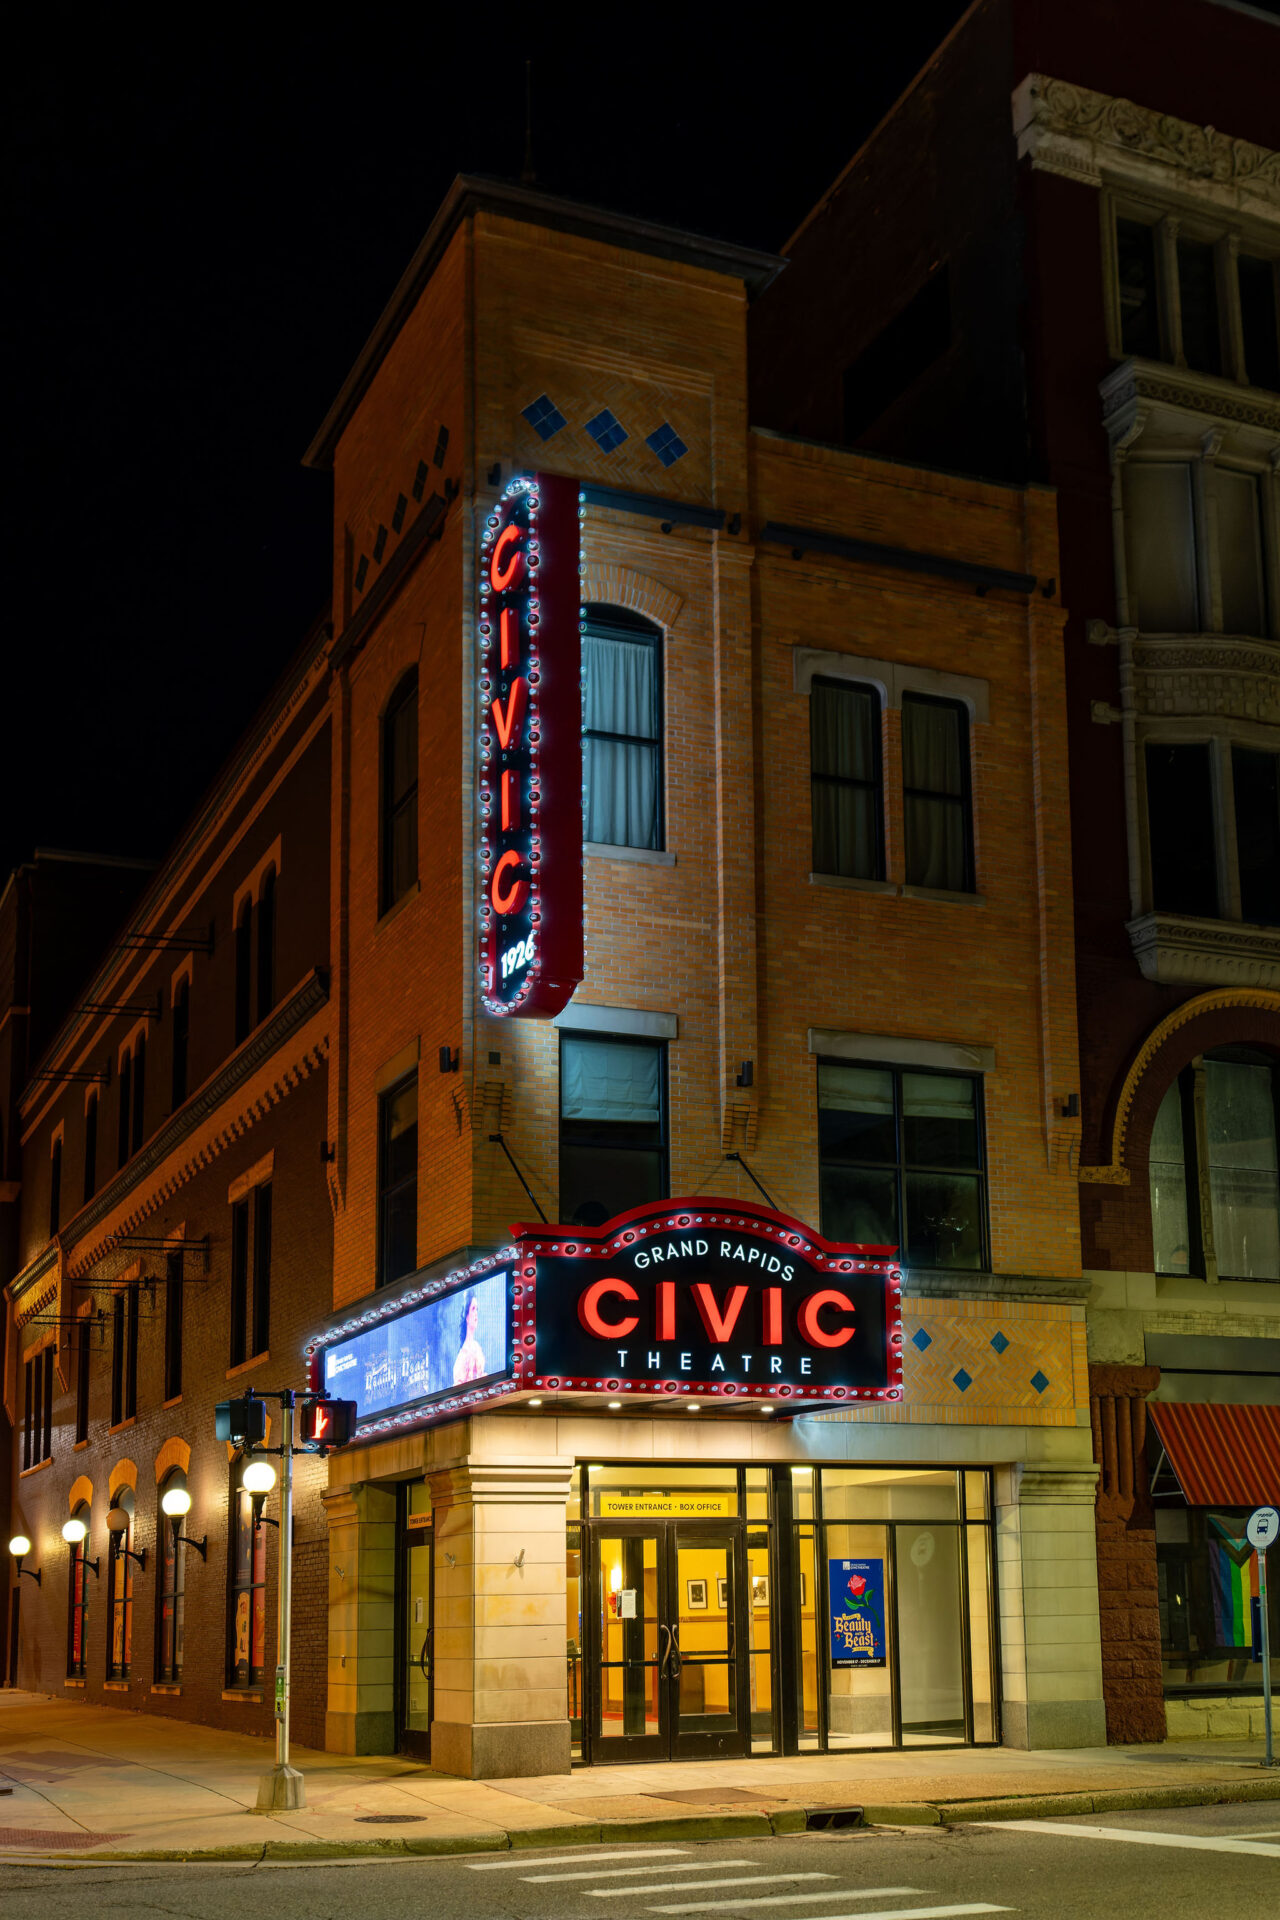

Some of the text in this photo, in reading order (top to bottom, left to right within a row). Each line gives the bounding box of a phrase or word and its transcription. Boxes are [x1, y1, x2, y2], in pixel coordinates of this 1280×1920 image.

[490, 524, 530, 915] CIVIC
[501, 933, 535, 979] 1926
[634, 1239, 795, 1282] GRAND RAPIDS
[577, 1277, 857, 1349] CIVIC
[617, 1350, 812, 1375] THEATRE
[608, 1503, 722, 1511] TOWER ENTRANCE BOX OFFICE
[833, 1616, 871, 1633] Beauty
[843, 1631, 874, 1648] Beast
